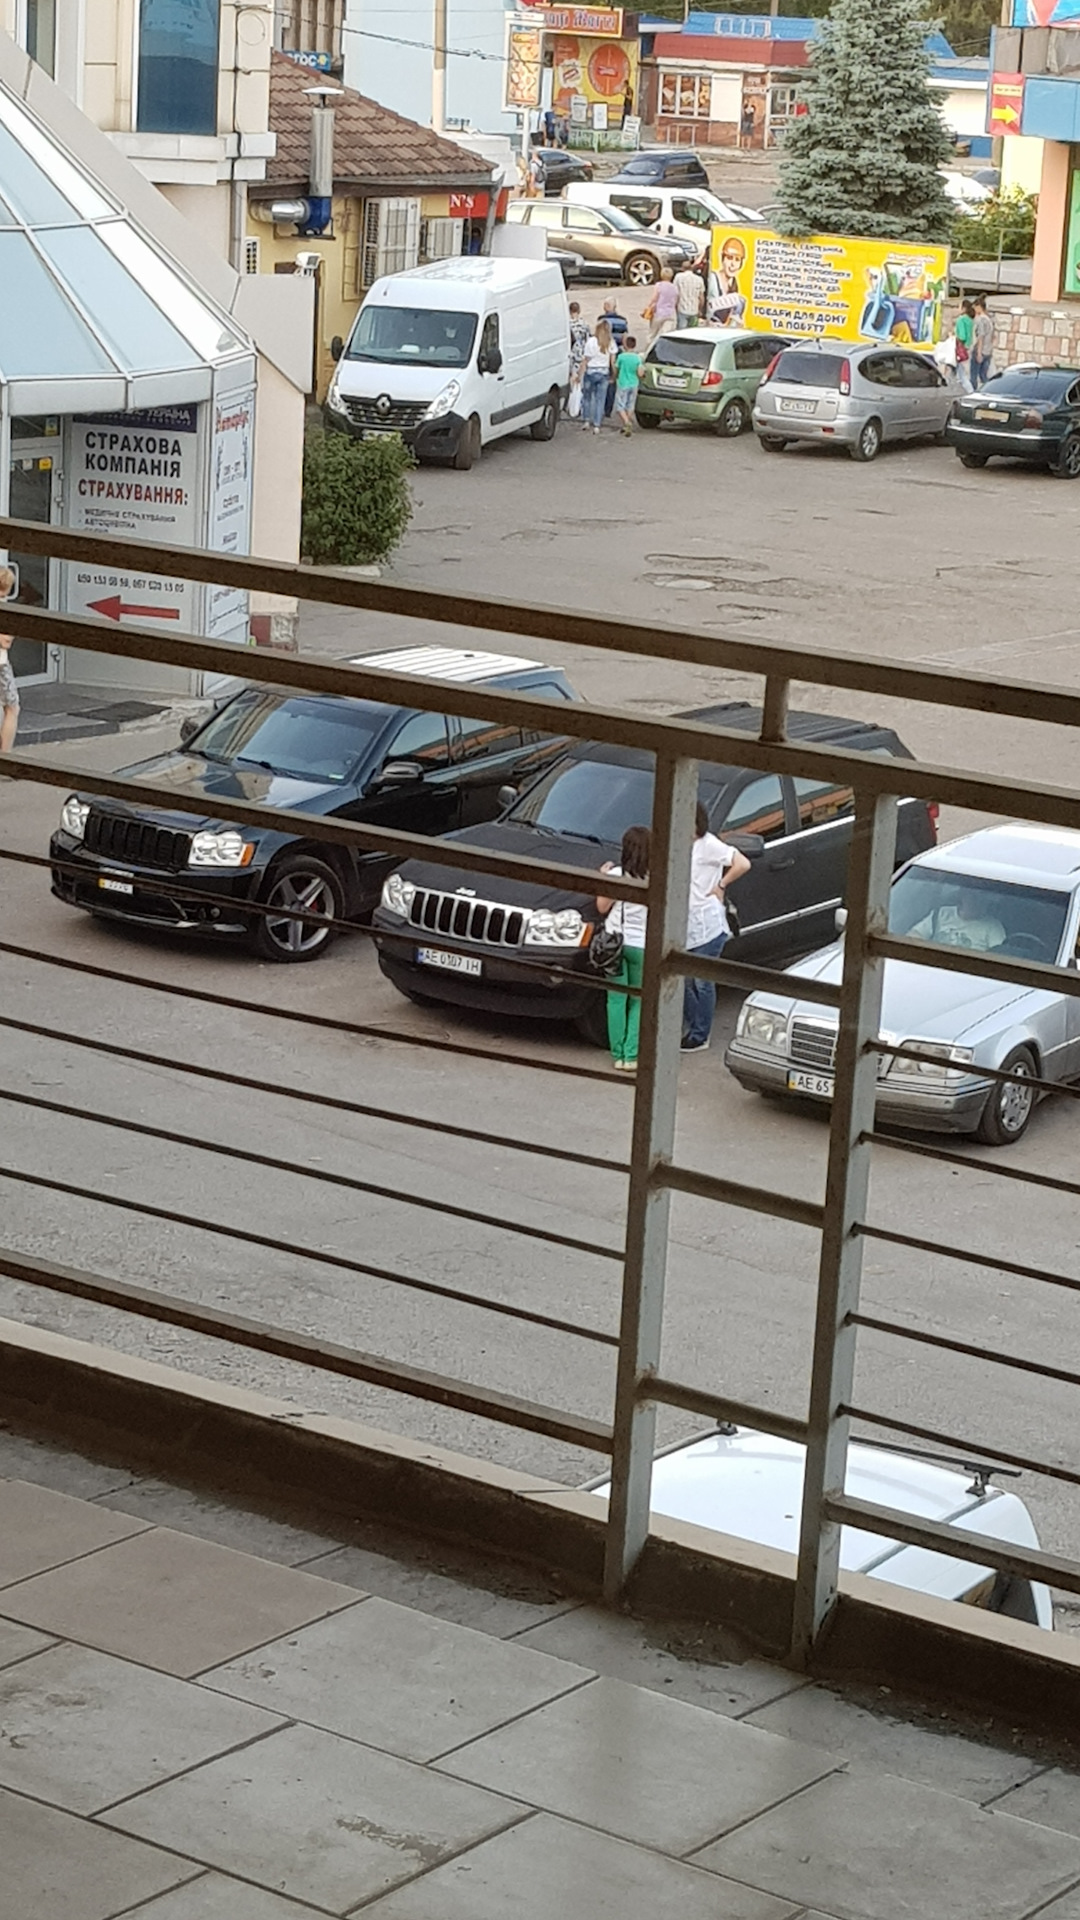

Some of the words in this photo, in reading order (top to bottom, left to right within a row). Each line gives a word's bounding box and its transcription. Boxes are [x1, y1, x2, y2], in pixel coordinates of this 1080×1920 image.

[772, 319, 784, 328] ТА
[816, 313, 846, 324] ДОМУ
[85, 431, 182, 457] СТРАХОВА
[85, 453, 181, 478] КОМПАНІЯ
[78, 478, 188, 506] СТРАХУВАННЯ:
[798, 1076, 813, 1090] AE
